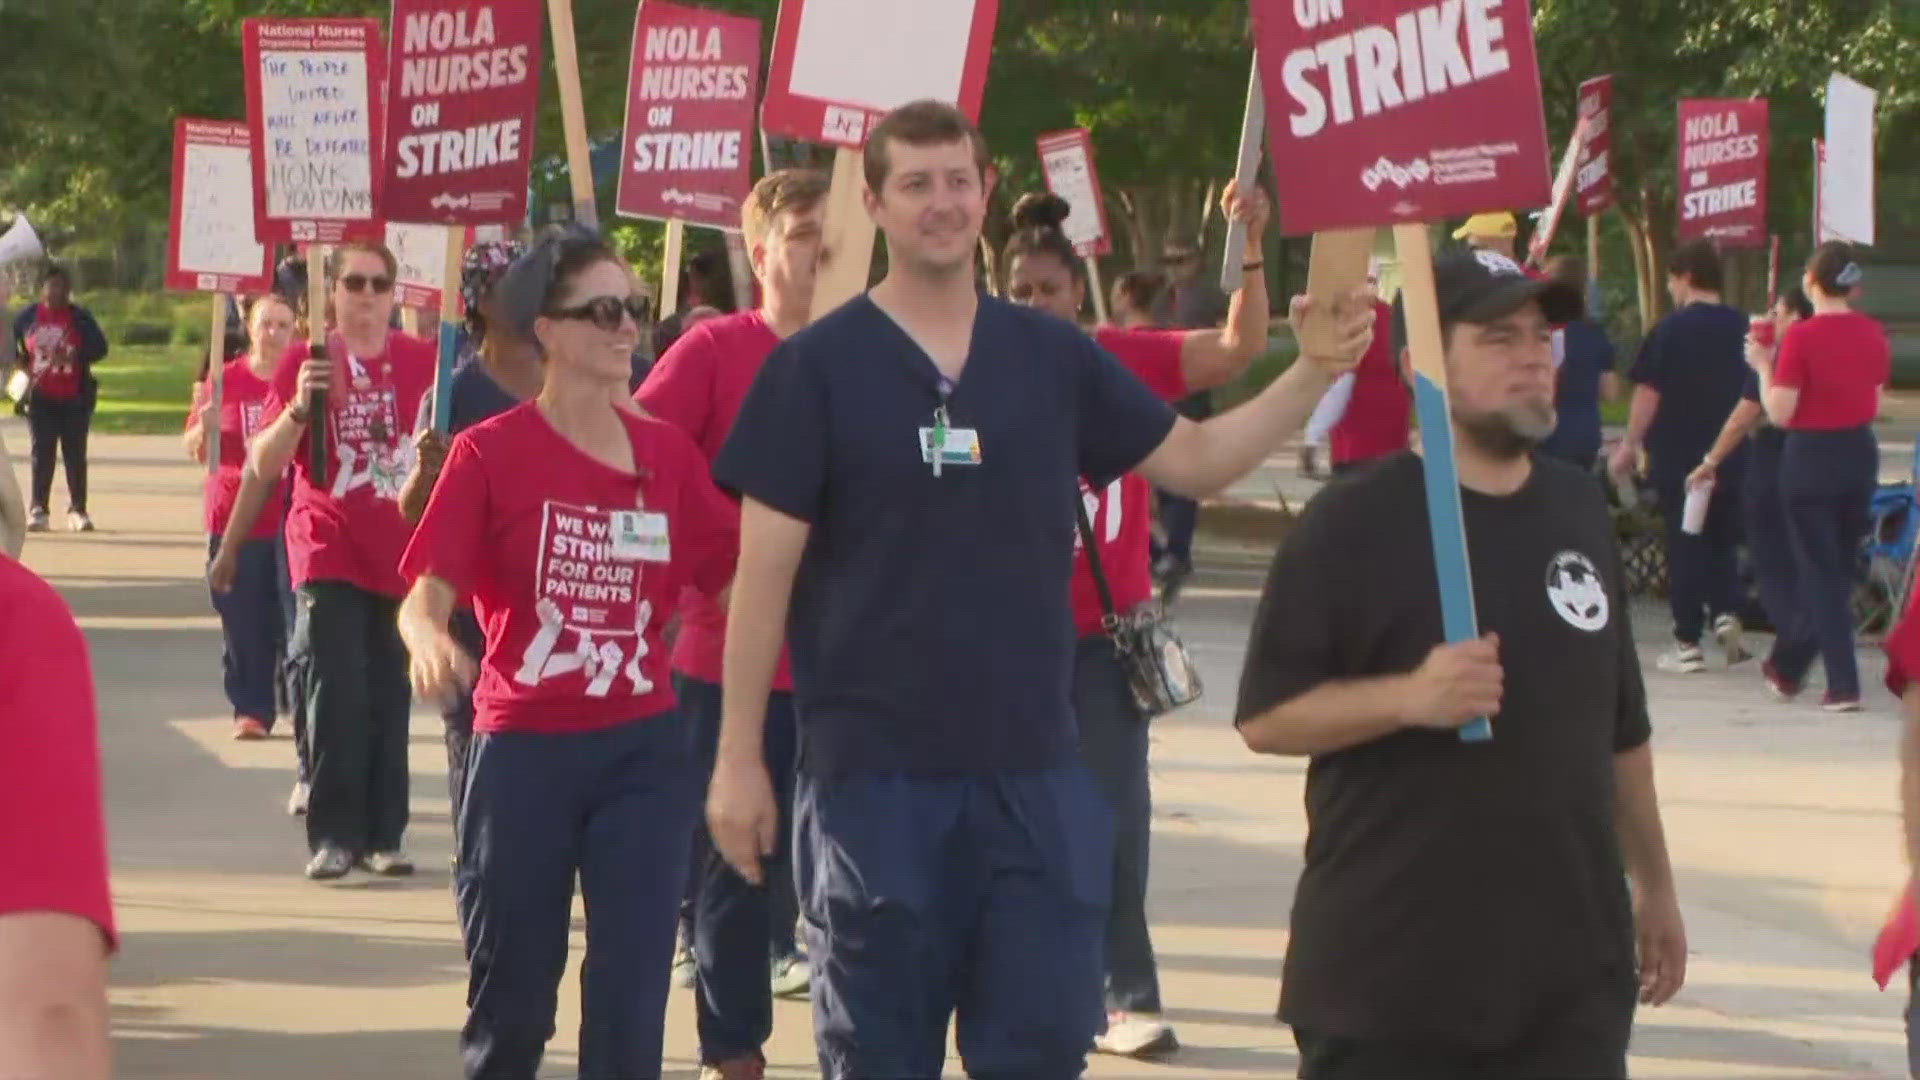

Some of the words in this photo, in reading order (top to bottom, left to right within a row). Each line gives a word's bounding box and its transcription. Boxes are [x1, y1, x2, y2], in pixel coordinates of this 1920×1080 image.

[258, 24, 316, 38] National
[319, 25, 366, 39] Nurses
[404, 6, 495, 53] NOLA
[644, 26, 722, 61] NOLA
[401, 45, 528, 97] NURSES
[640, 64, 749, 100] NURSES
[1281, 0, 1510, 138] STRIKE
[411, 102, 440, 128] ON
[647, 105, 673, 127] ON
[1685, 110, 1739, 142] NOLA
[396, 118, 521, 179] STRIKE
[633, 131, 742, 172] STRIKE
[1684, 133, 1759, 169] NURSES
[271, 160, 350, 192] HONK
[1682, 178, 1757, 220] STRIKE
[555, 512, 583, 536] WE
[552, 534, 611, 563] STRI
[548, 556, 589, 580] FOR
[592, 565, 635, 584] OUR
[546, 577, 632, 604] PATIENTS
